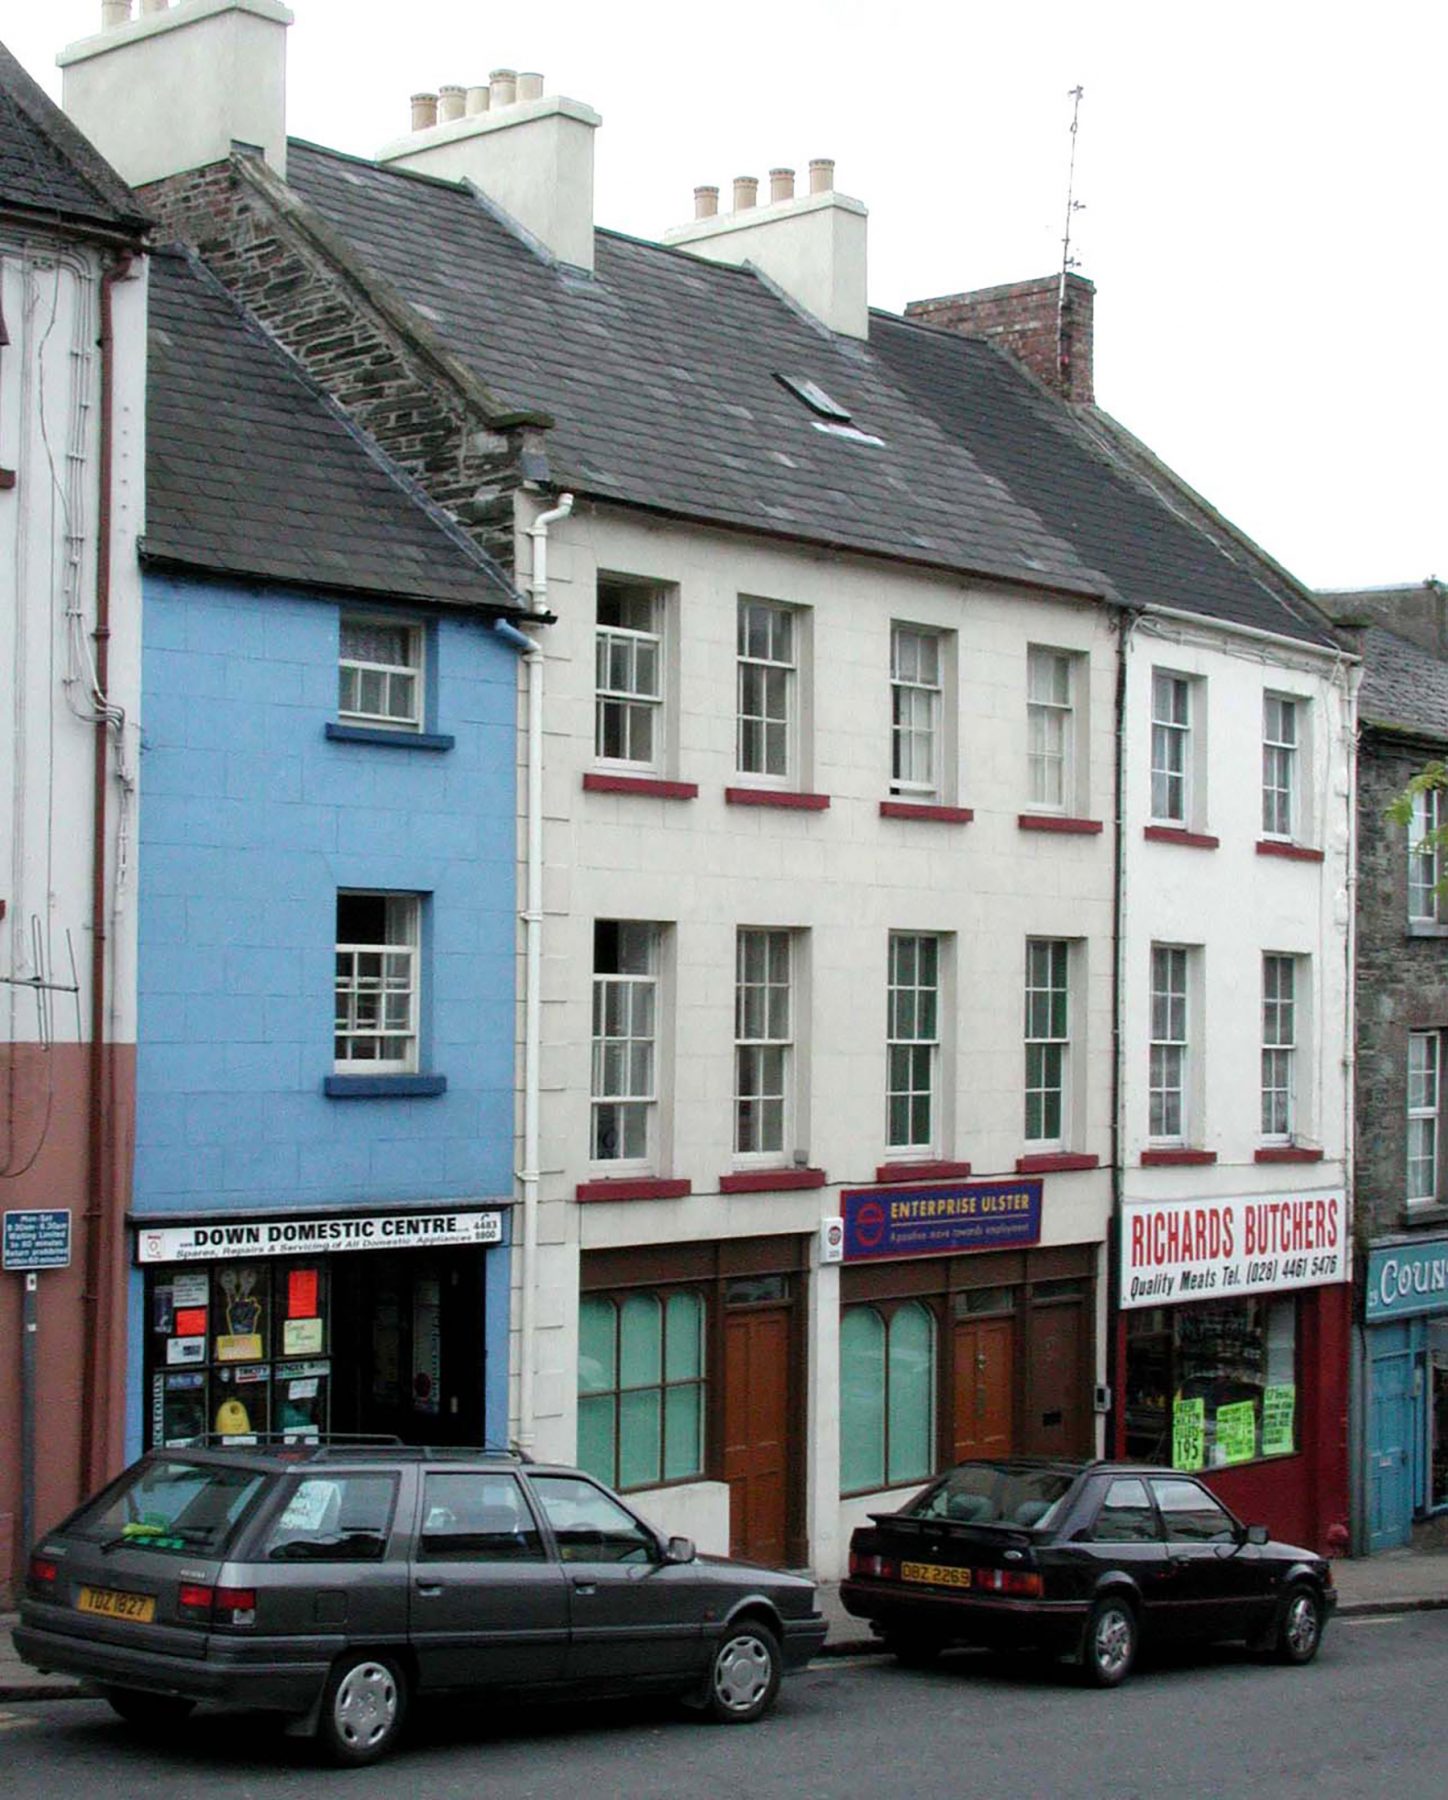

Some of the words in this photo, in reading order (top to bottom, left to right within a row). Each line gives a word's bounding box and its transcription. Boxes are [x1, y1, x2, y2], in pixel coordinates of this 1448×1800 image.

[890, 1197, 977, 1219] ENTERPRISE
[982, 1194, 1029, 1212] ULSTER
[194, 1228, 260, 1246] DOWN
[268, 1220, 374, 1242] DOMESTIC
[382, 1216, 457, 1237] CENTRE
[986, 1223, 1030, 1237] employment
[1131, 1207, 1234, 1267] RICHARDS
[1244, 1199, 1338, 1256] BUTCHERS
[176, 1246, 218, 1260] Spares,
[222, 1243, 264, 1257] Repairs
[279, 1238, 329, 1254] Servicing
[345, 1238, 359, 1248] All
[362, 1236, 411, 1249] Domestic
[415, 1232, 472, 1246] Appliances
[1130, 1271, 1174, 1301] Quality
[1179, 1266, 1216, 1291] Meats
[1222, 1265, 1240, 1287] Tel.
[1246, 1258, 1277, 1285] (028)
[1282, 1257, 1307, 1281] 4461
[1310, 1254, 1338, 1277] 5476
[1381, 1260, 1448, 1304] COUN
